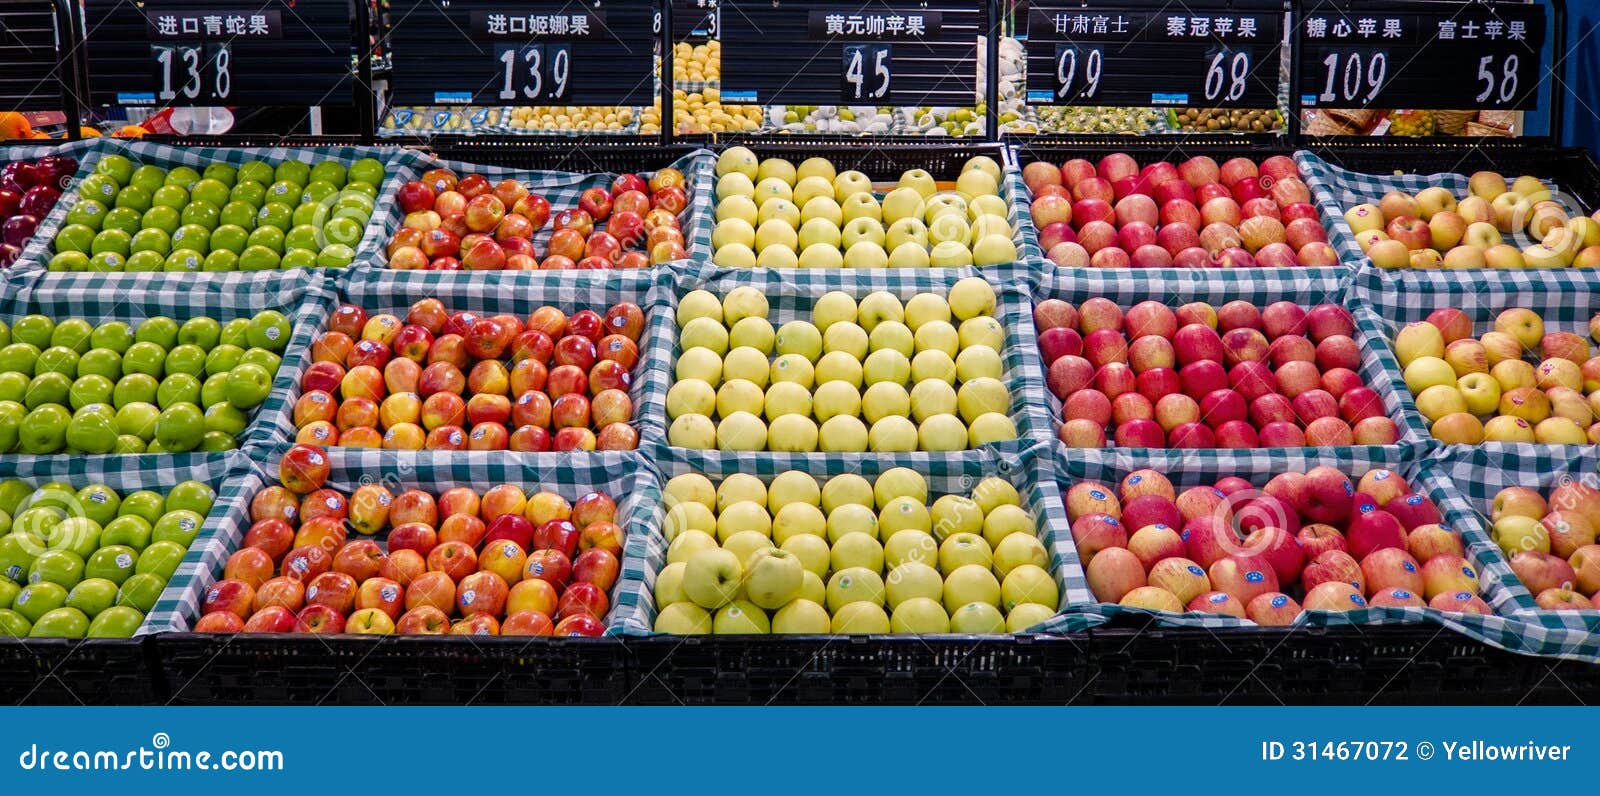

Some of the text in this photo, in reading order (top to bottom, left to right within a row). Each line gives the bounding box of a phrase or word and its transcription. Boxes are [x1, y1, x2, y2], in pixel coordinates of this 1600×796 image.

[158, 15, 269, 35] 进口青蛇果
[487, 15, 590, 35] 进口姬娜果
[825, 15, 926, 35] 黄元帅苹果
[1053, 14, 1129, 34] 甘肃富士
[1167, 17, 1257, 38] 秦冠苹果
[1307, 18, 1402, 38] 糖心苹果
[1438, 20, 1527, 40] 富士苹果
[158, 50, 230, 100] 13.8
[500, 49, 568, 99] 13.9
[846, 50, 890, 99] 4.5
[1058, 49, 1101, 98] 9.9
[1205, 52, 1248, 101] 6.8
[1320, 52, 1386, 104] 10.9
[1476, 54, 1518, 103] 5.8
